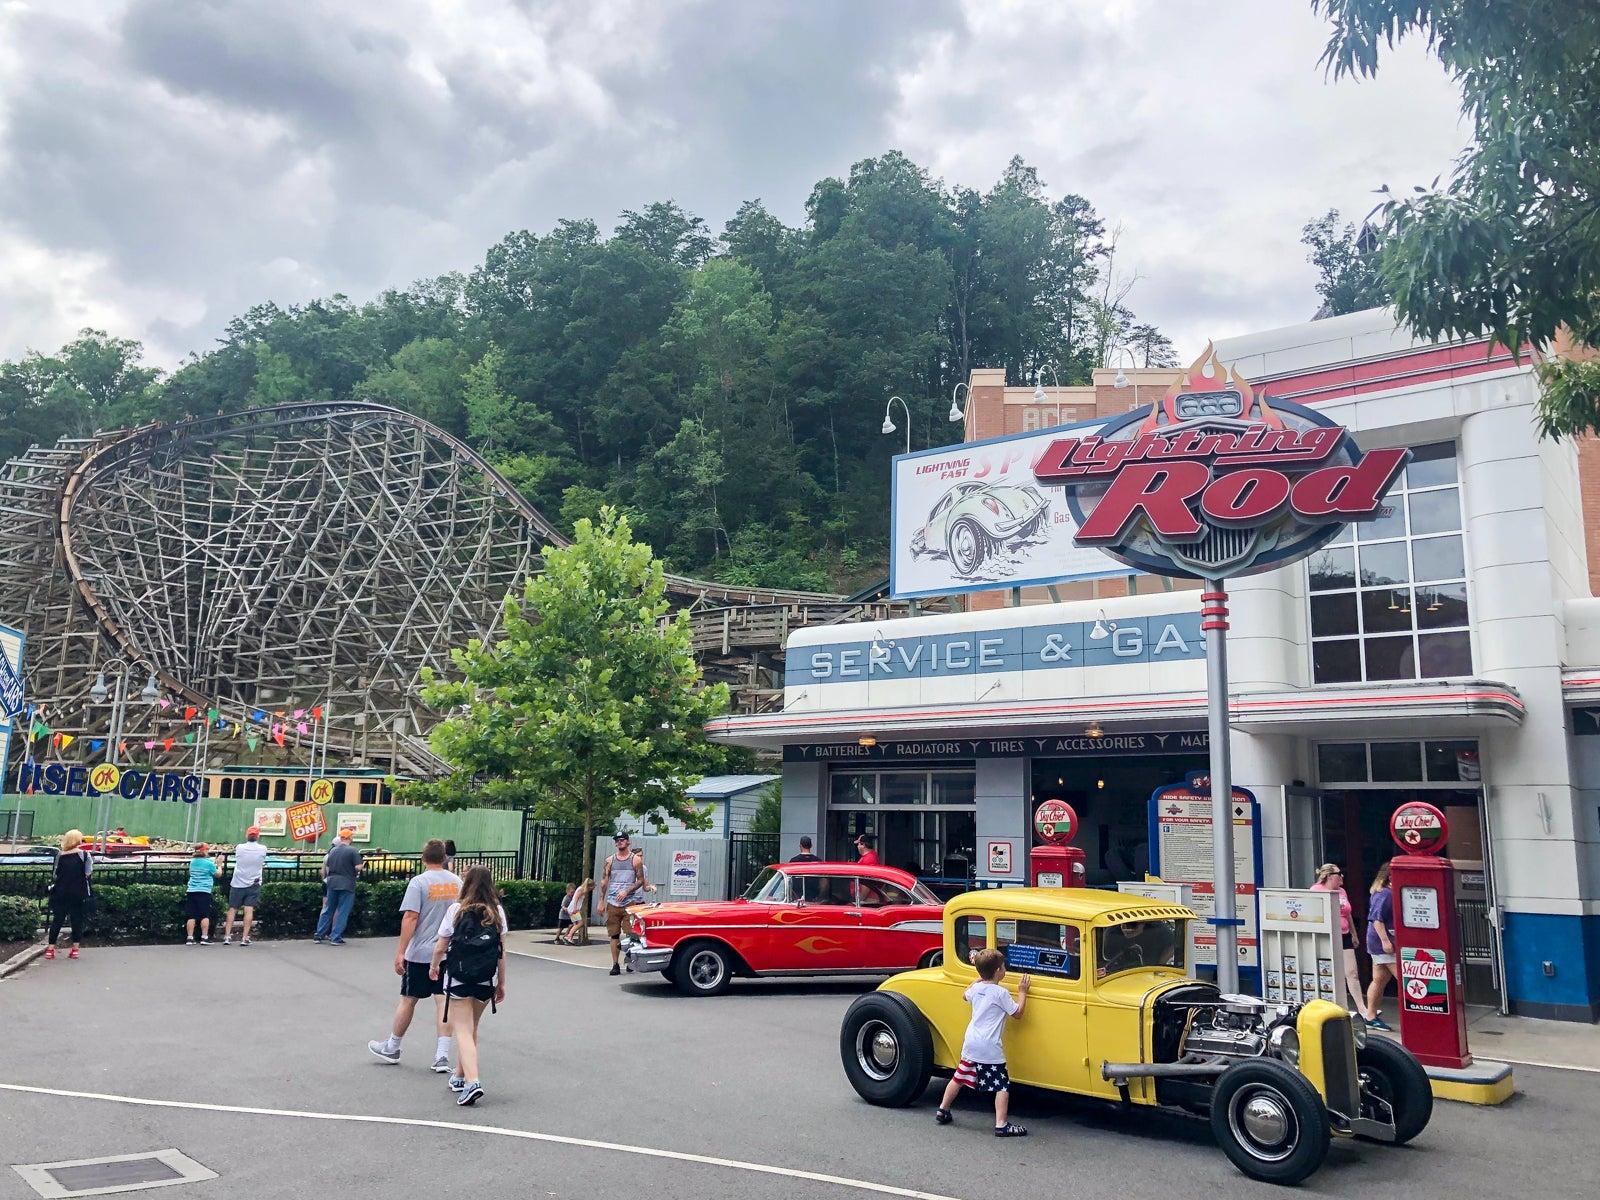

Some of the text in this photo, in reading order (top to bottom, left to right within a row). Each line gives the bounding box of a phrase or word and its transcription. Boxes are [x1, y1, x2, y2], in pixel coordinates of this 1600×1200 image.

[1033, 424, 1347, 476] Lightning
[916, 458, 971, 475] LIGHTNING
[940, 468, 969, 480] FAST
[1073, 447, 1409, 540] Rod
[1054, 511, 1070, 524] Gas
[811, 624, 1207, 678] SERVICE & GA
[815, 744, 871, 757] BATTERIES
[896, 742, 961, 755] RADIATORS
[989, 740, 1025, 752] TIRES
[1055, 736, 1146, 751] ACCESSORIES
[94, 768, 114, 787] OK
[119, 769, 200, 804] CARS
[313, 782, 330, 800] OK
[290, 803, 318, 817] DRIVE
[292, 812, 319, 828] BUY
[1400, 815, 1435, 829] Sky Chief
[295, 821, 323, 837] ONE
[1402, 961, 1419, 979] Sky
[1420, 962, 1446, 977] Chief
[1410, 1004, 1444, 1012] GASOLINE
